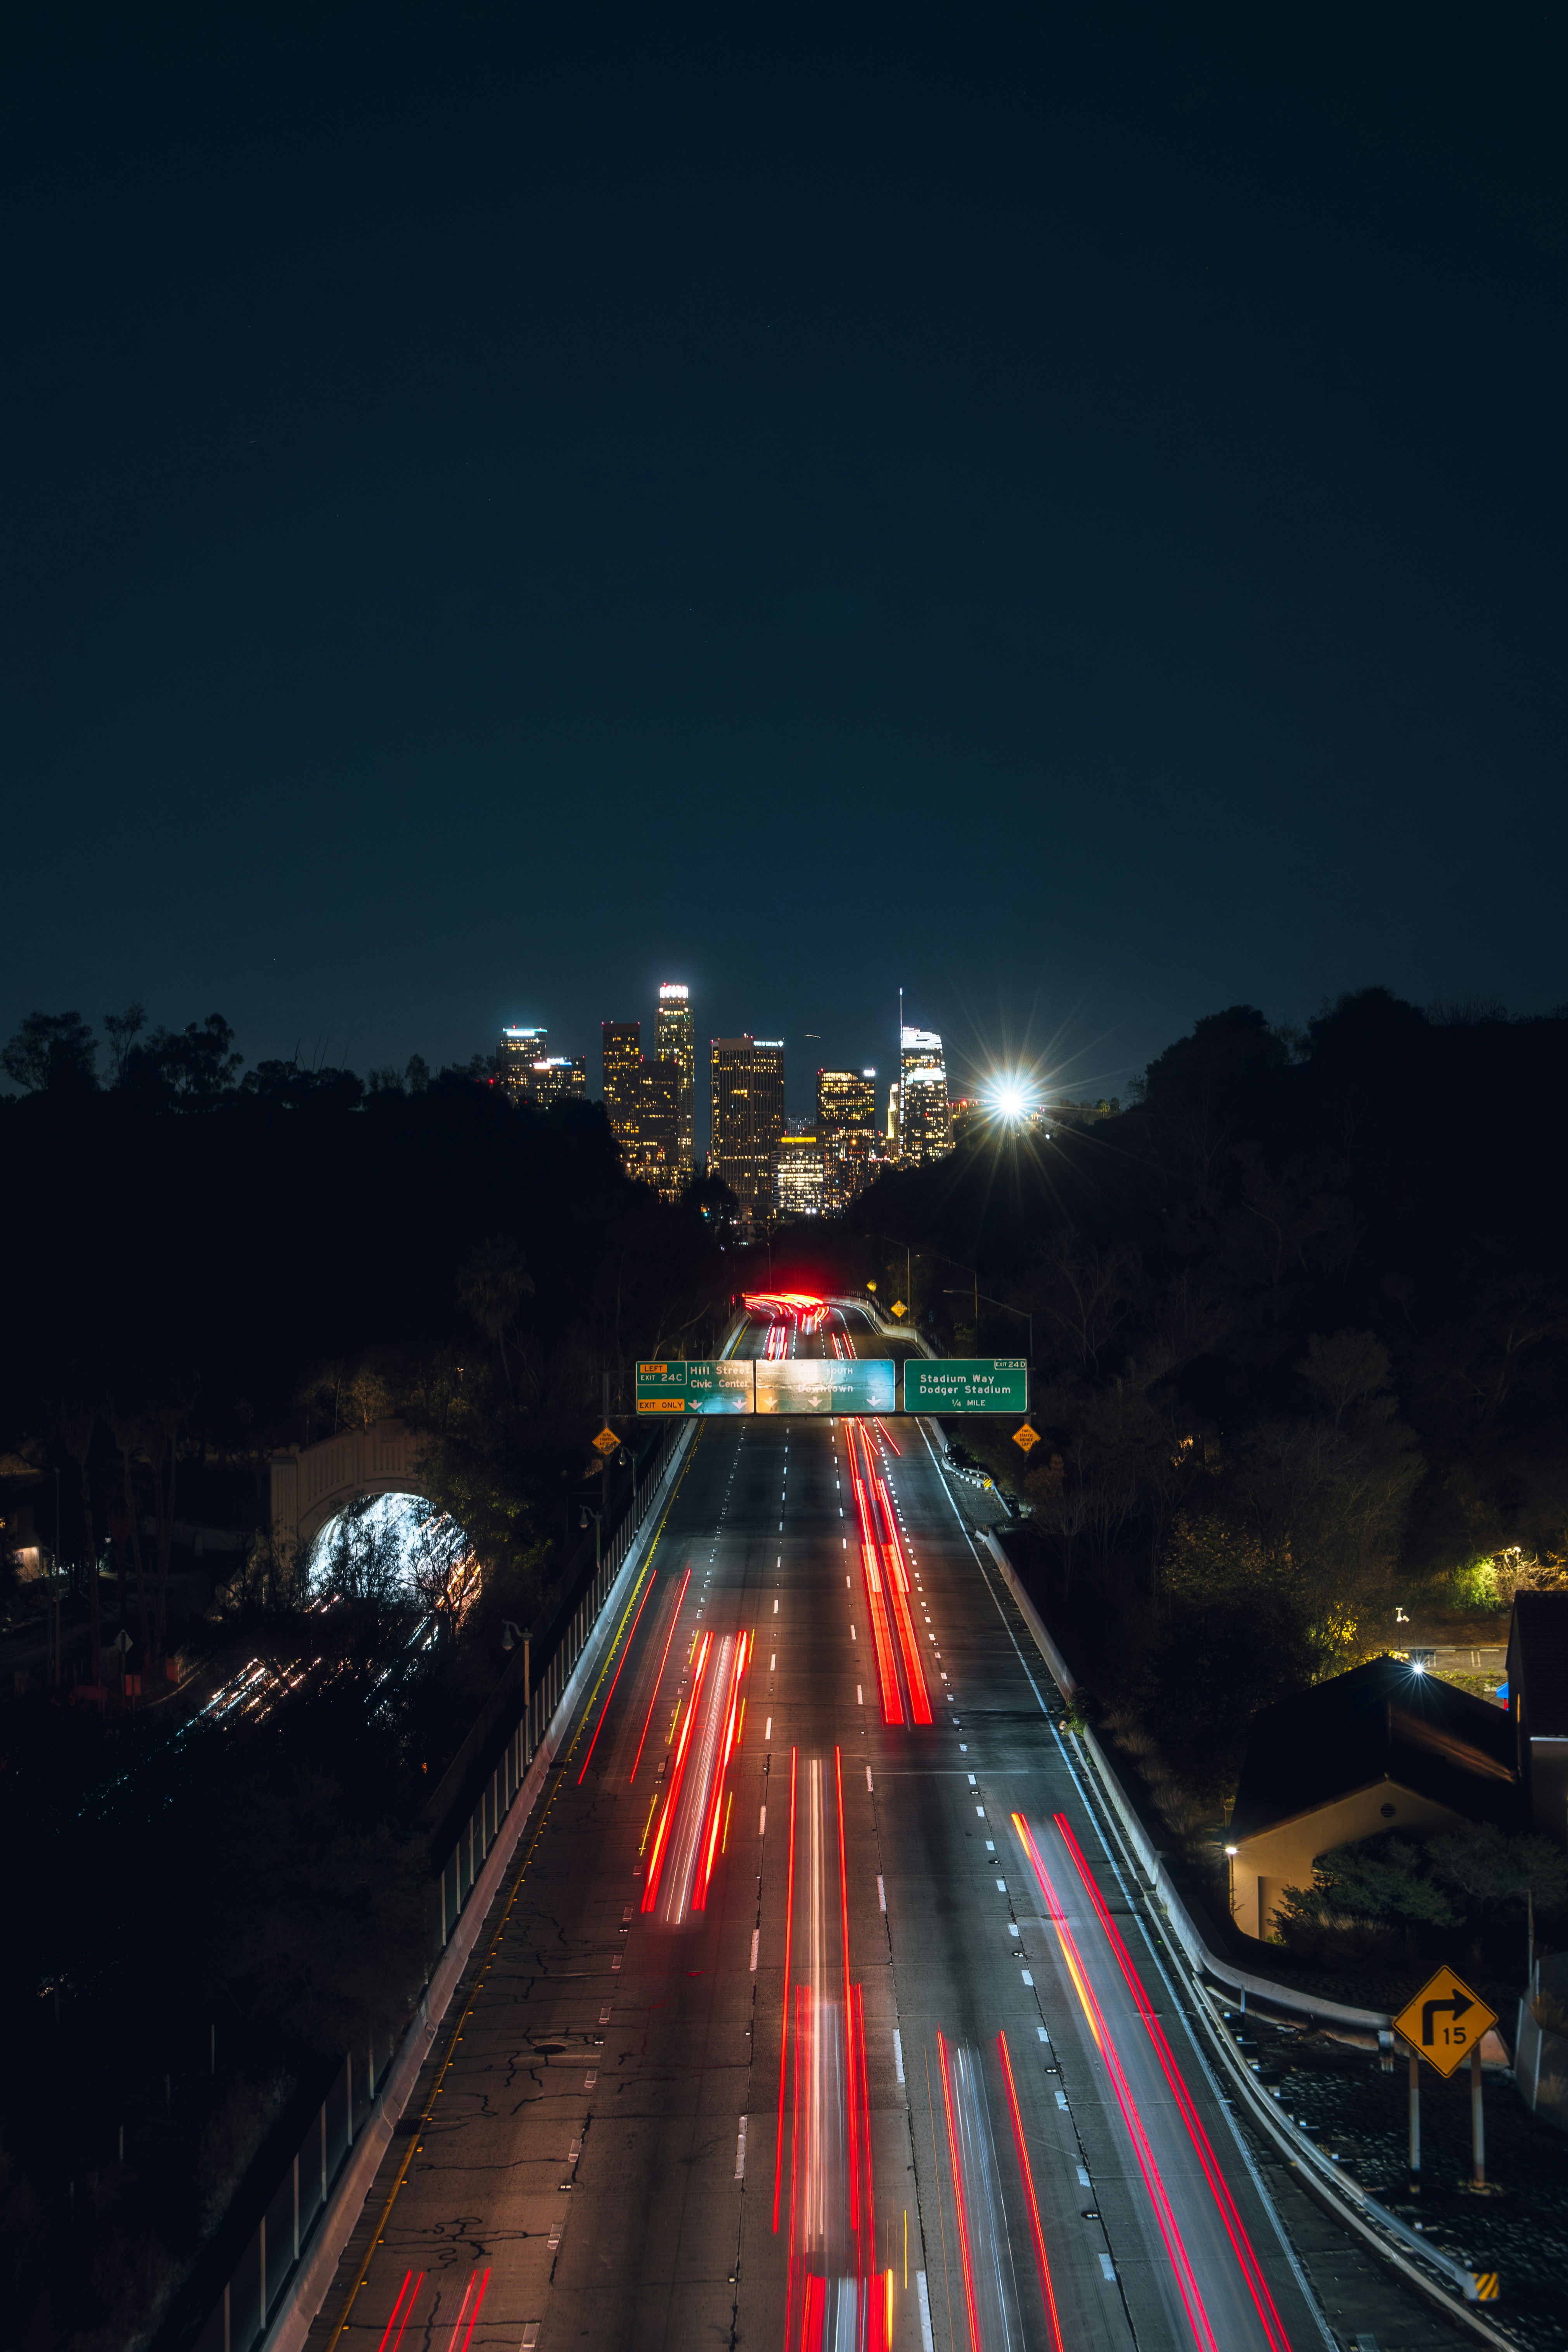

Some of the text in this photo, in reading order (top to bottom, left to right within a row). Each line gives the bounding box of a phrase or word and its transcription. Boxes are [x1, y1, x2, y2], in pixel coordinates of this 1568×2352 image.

[690, 1366, 749, 1375] Hill Street
[661, 1374, 682, 1382] 24C
[920, 1374, 994, 1384] Stadium Way
[691, 1379, 749, 1388] Civic Center
[920, 1385, 1011, 1396] Dodger Stadium
[1443, 2027, 1466, 2045] 15
